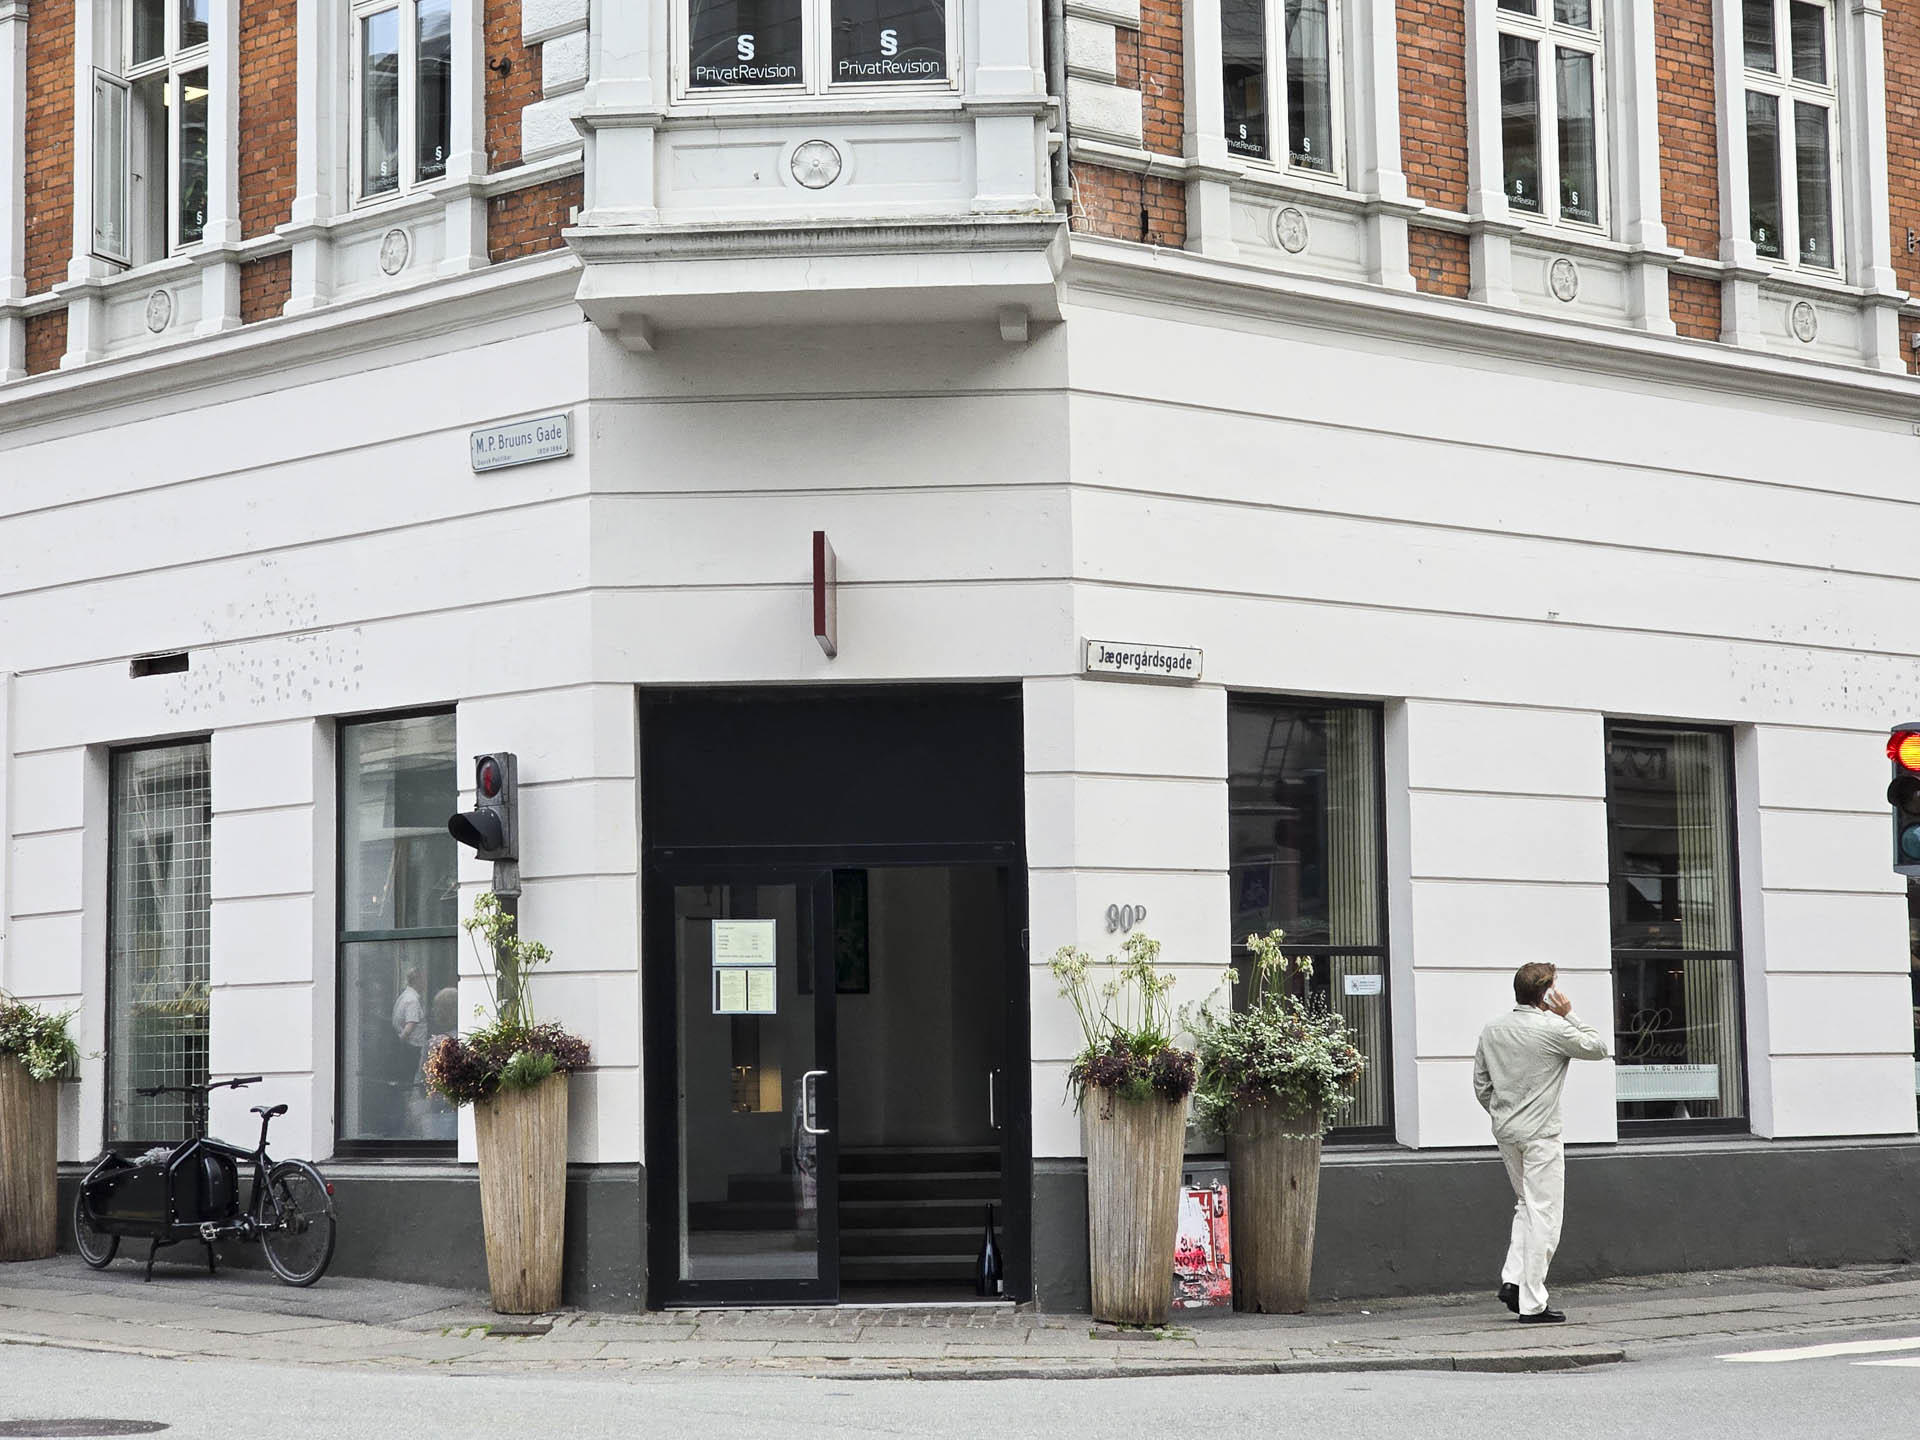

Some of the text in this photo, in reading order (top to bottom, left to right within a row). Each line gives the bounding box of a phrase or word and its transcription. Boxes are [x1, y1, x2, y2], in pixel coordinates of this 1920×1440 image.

[696, 64, 796, 81] PrivatRevision
[839, 59, 939, 76] PrivatRevision
[476, 424, 562, 454] M.P. Bruuns Gade
[1098, 646, 1193, 673] Jægergårdsgade
[1104, 903, 1147, 934] 90D
